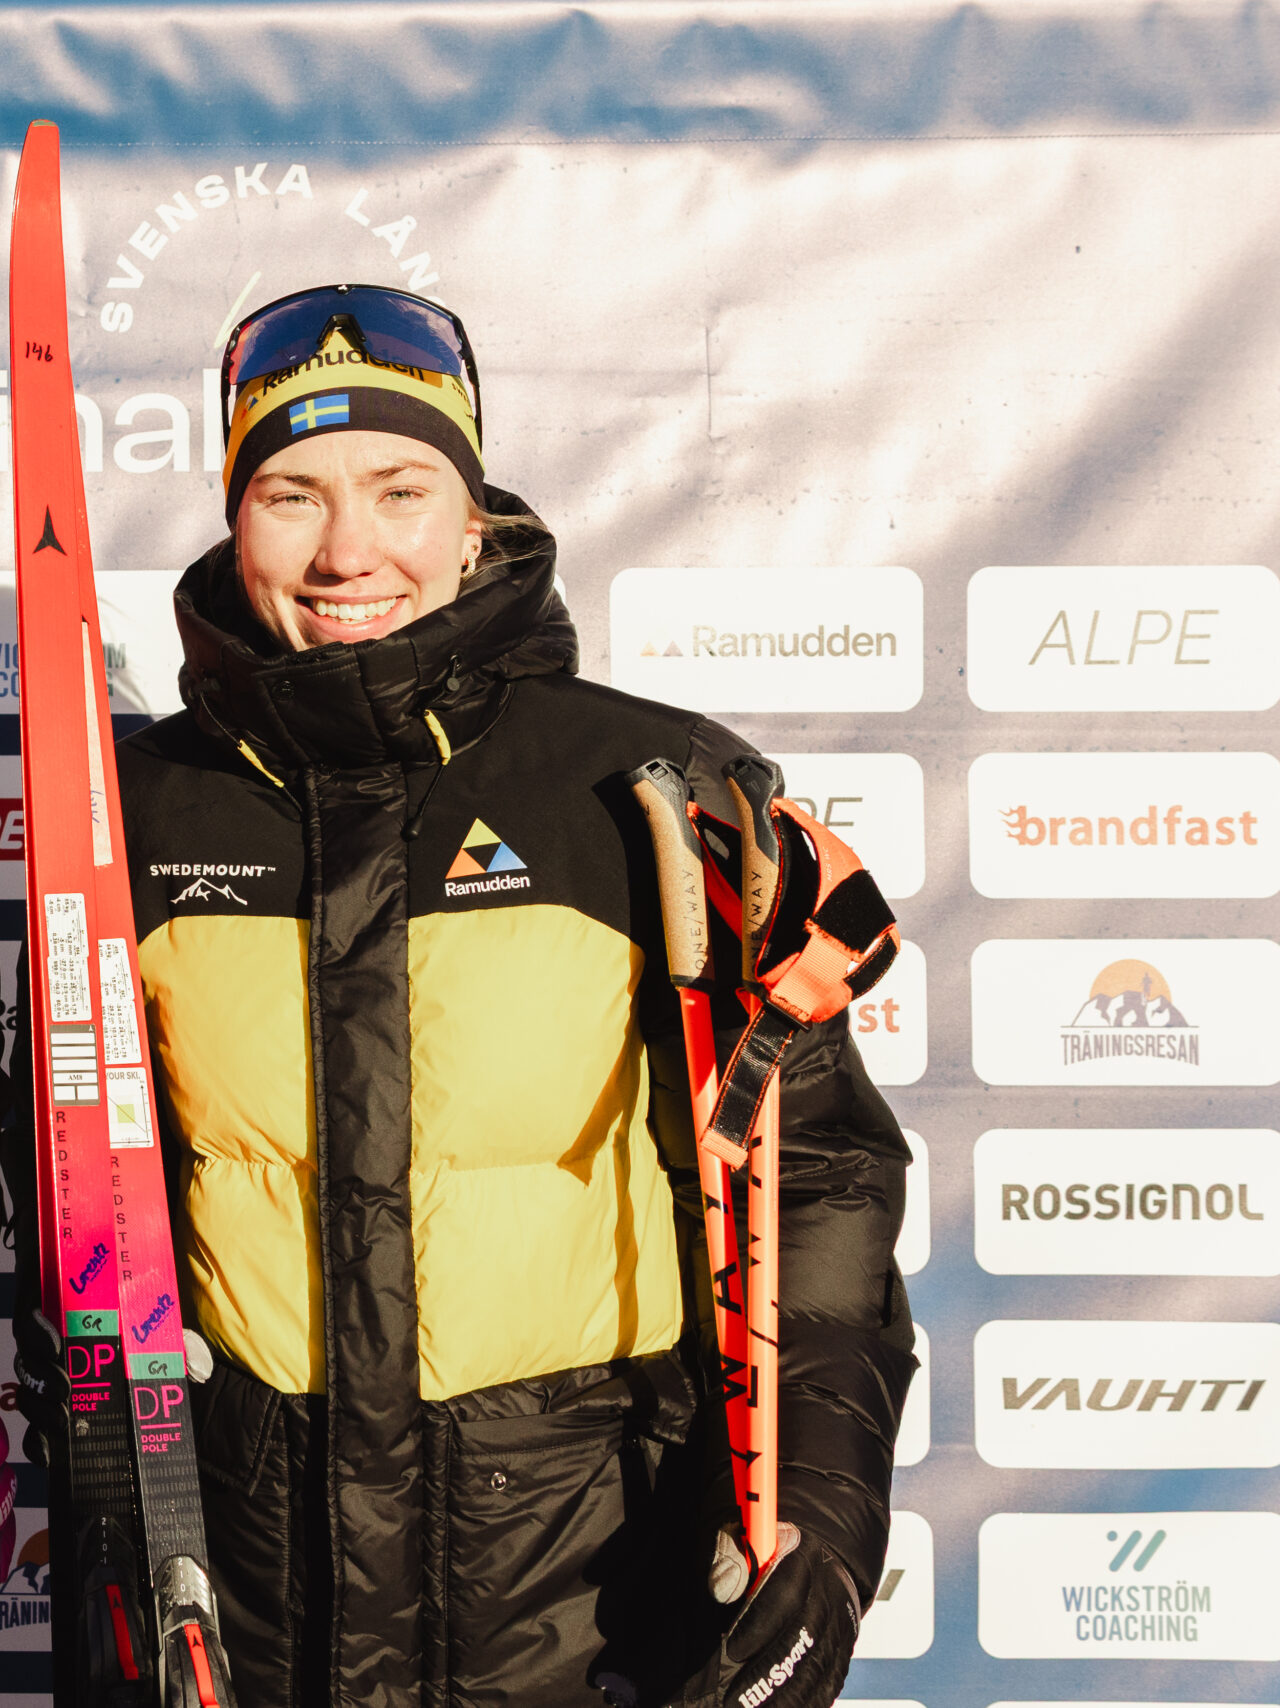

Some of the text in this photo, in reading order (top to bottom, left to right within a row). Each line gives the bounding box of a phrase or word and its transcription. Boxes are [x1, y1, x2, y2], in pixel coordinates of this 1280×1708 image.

[101, 162, 314, 333] SVENSKA
[24, 341, 54, 363] 146
[692, 624, 897, 658] Ramudden
[1028, 609, 1220, 666] ALPE
[1019, 804, 1258, 847] brandfast
[444, 874, 531, 898] Ramudden
[1060, 1028, 1200, 1068] TRÄNINGSRESAN
[107, 1072, 125, 1080] OUR
[56, 1111, 73, 1239] REDSTER
[110, 1156, 133, 1281] REDSTER
[1001, 1183, 1264, 1222] ROSSIGNOL
[68, 1344, 115, 1379] DP
[72, 1391, 110, 1402] DOUBLE
[72, 1402, 97, 1412] POLE
[133, 1384, 184, 1420] DP
[1001, 1378, 1266, 1413] VAUHTI
[141, 1433, 181, 1443] DOUBLE
[142, 1443, 168, 1453] POLE
[1061, 1580, 1212, 1613] WICKSTRÖM
[1075, 1614, 1198, 1643] COACHING
